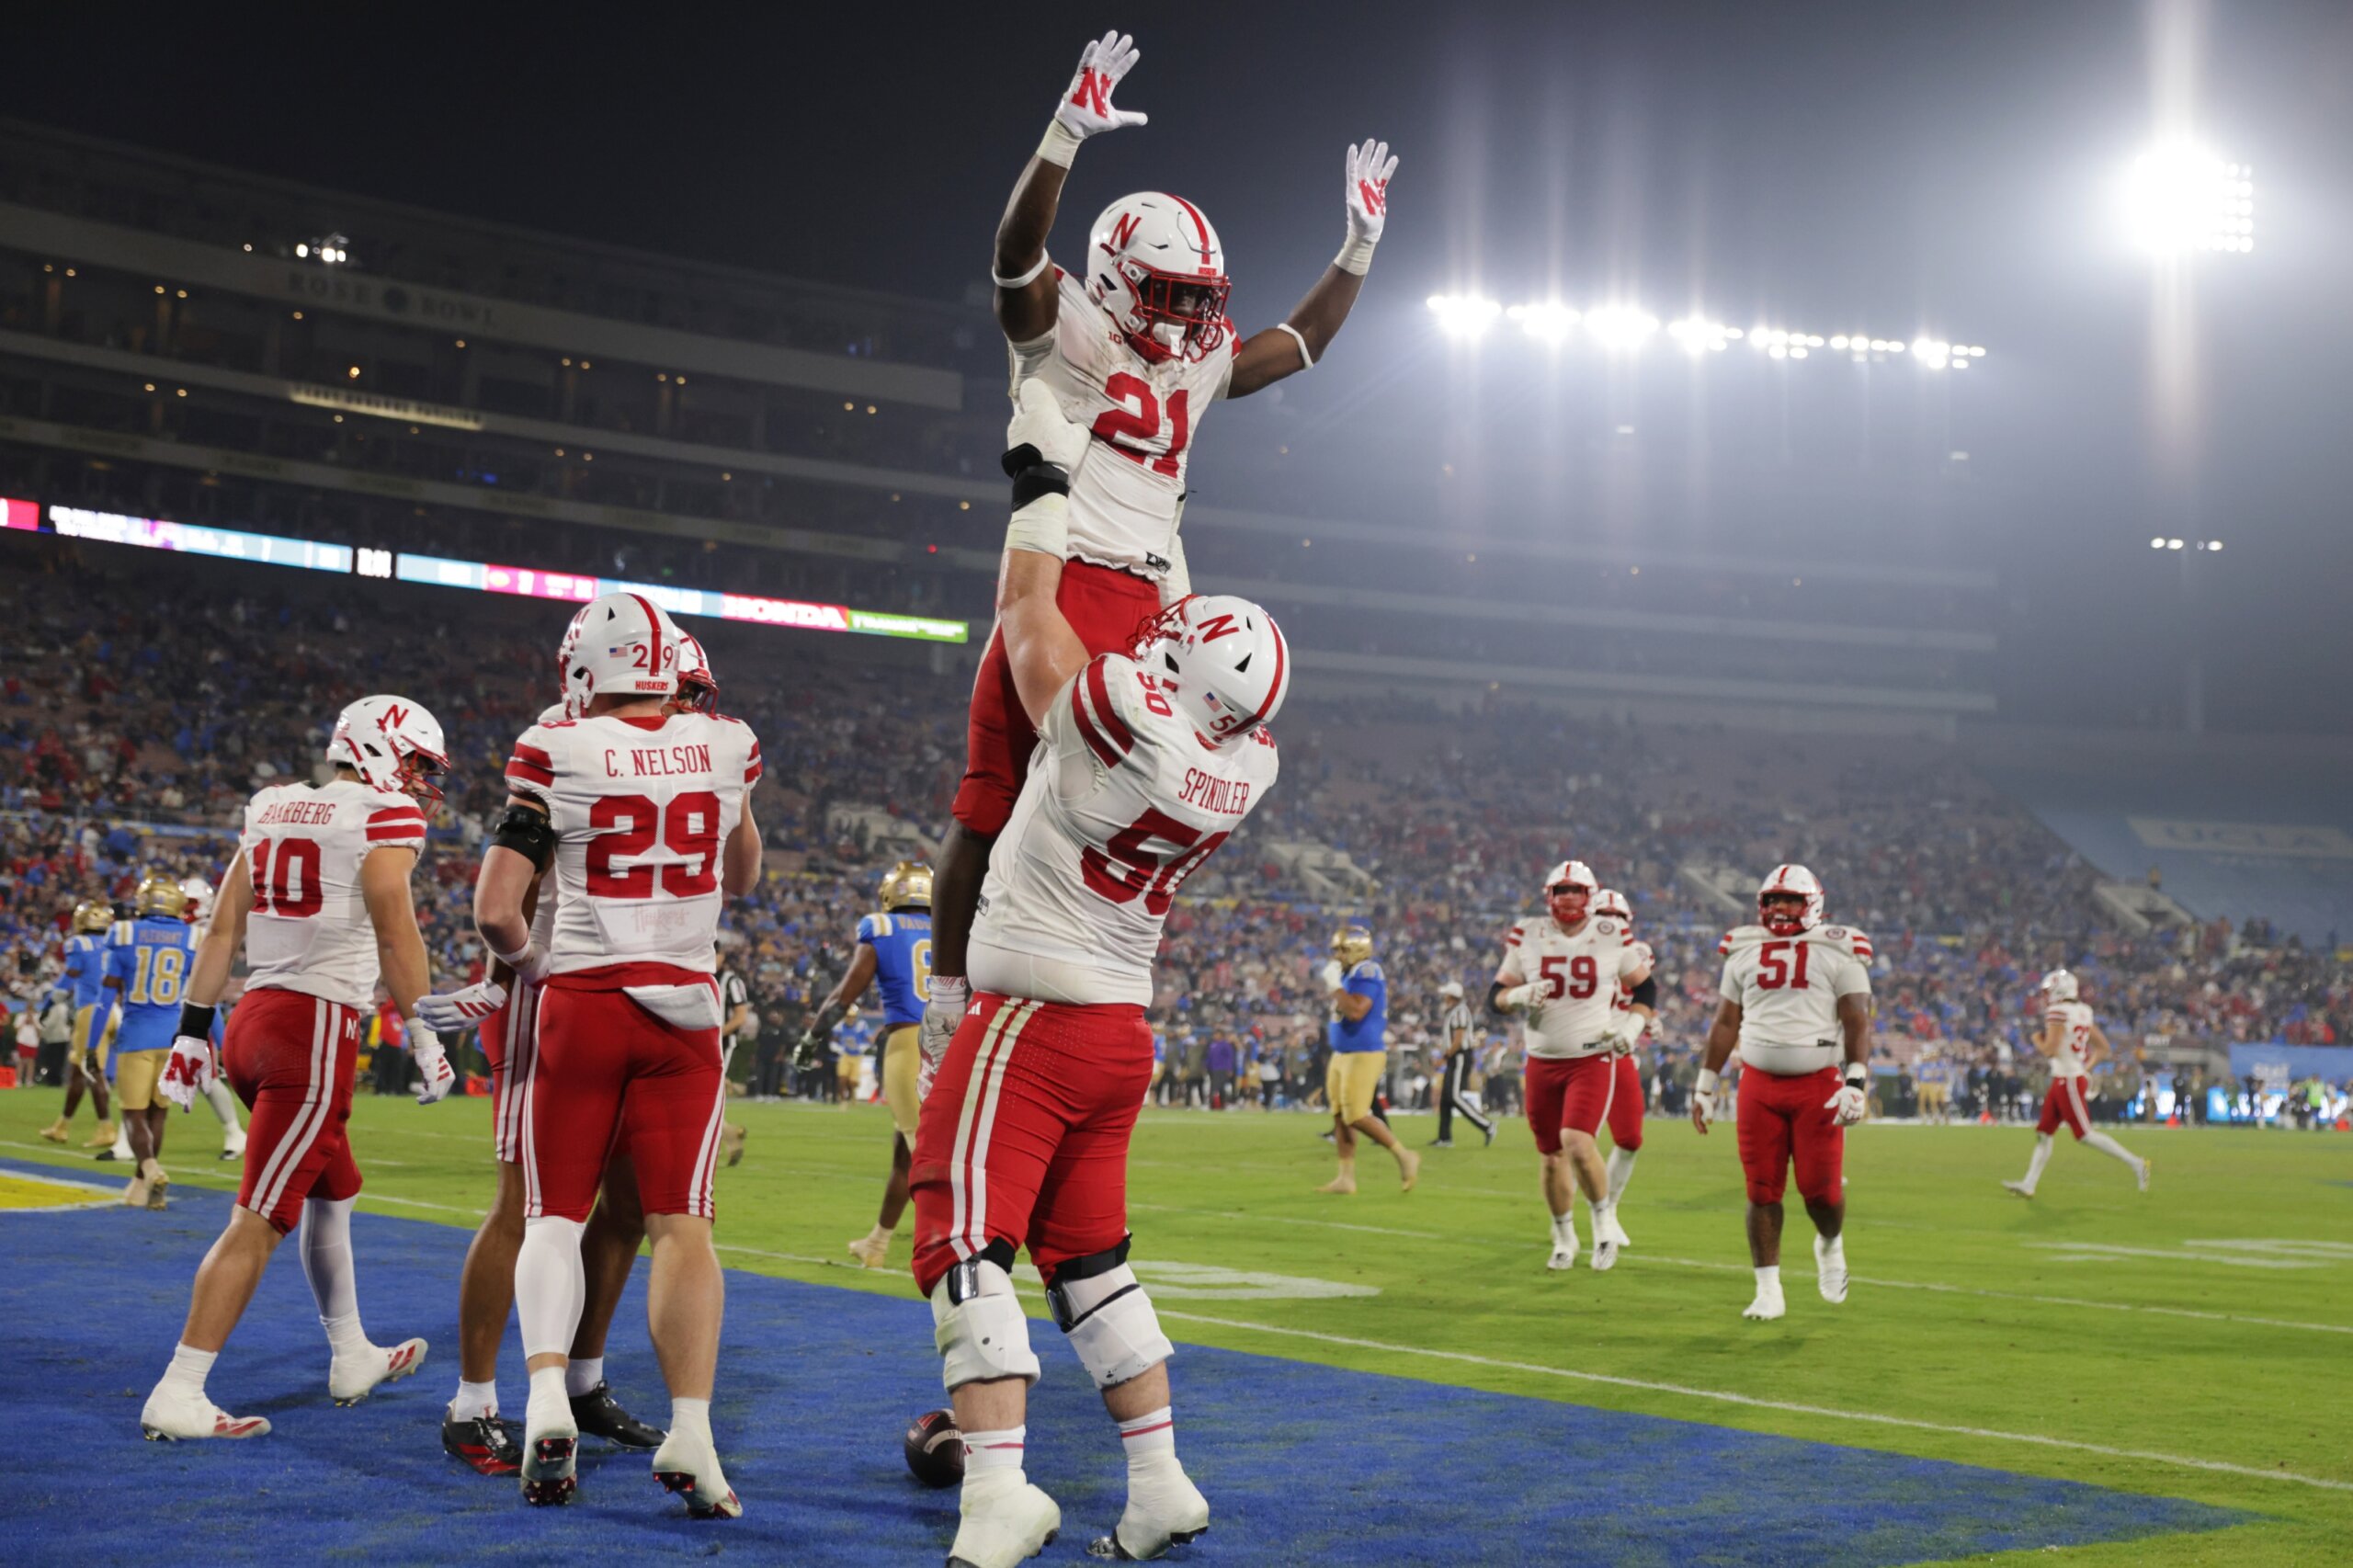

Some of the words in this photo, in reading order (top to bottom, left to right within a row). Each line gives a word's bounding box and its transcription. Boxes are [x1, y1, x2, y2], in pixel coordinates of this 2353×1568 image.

[1070, 66, 1113, 119] N
[1108, 212, 1142, 250] N
[1092, 371, 1189, 480] 21
[723, 595, 847, 629] HONDA
[1197, 614, 1240, 643] N
[635, 680, 669, 691] HUSKERS
[382, 704, 409, 729] N
[605, 749, 624, 778] C.
[631, 744, 712, 777] NELSON
[1178, 767, 1250, 815] SPINDLER
[585, 791, 721, 899] 29
[1080, 807, 1230, 915] 50
[249, 837, 324, 918] 10
[128, 946, 185, 1006] 18
[1540, 956, 1597, 1000] 59
[1756, 940, 1809, 990] 51
[346, 1017, 358, 1040] N
[165, 1051, 204, 1086] N
